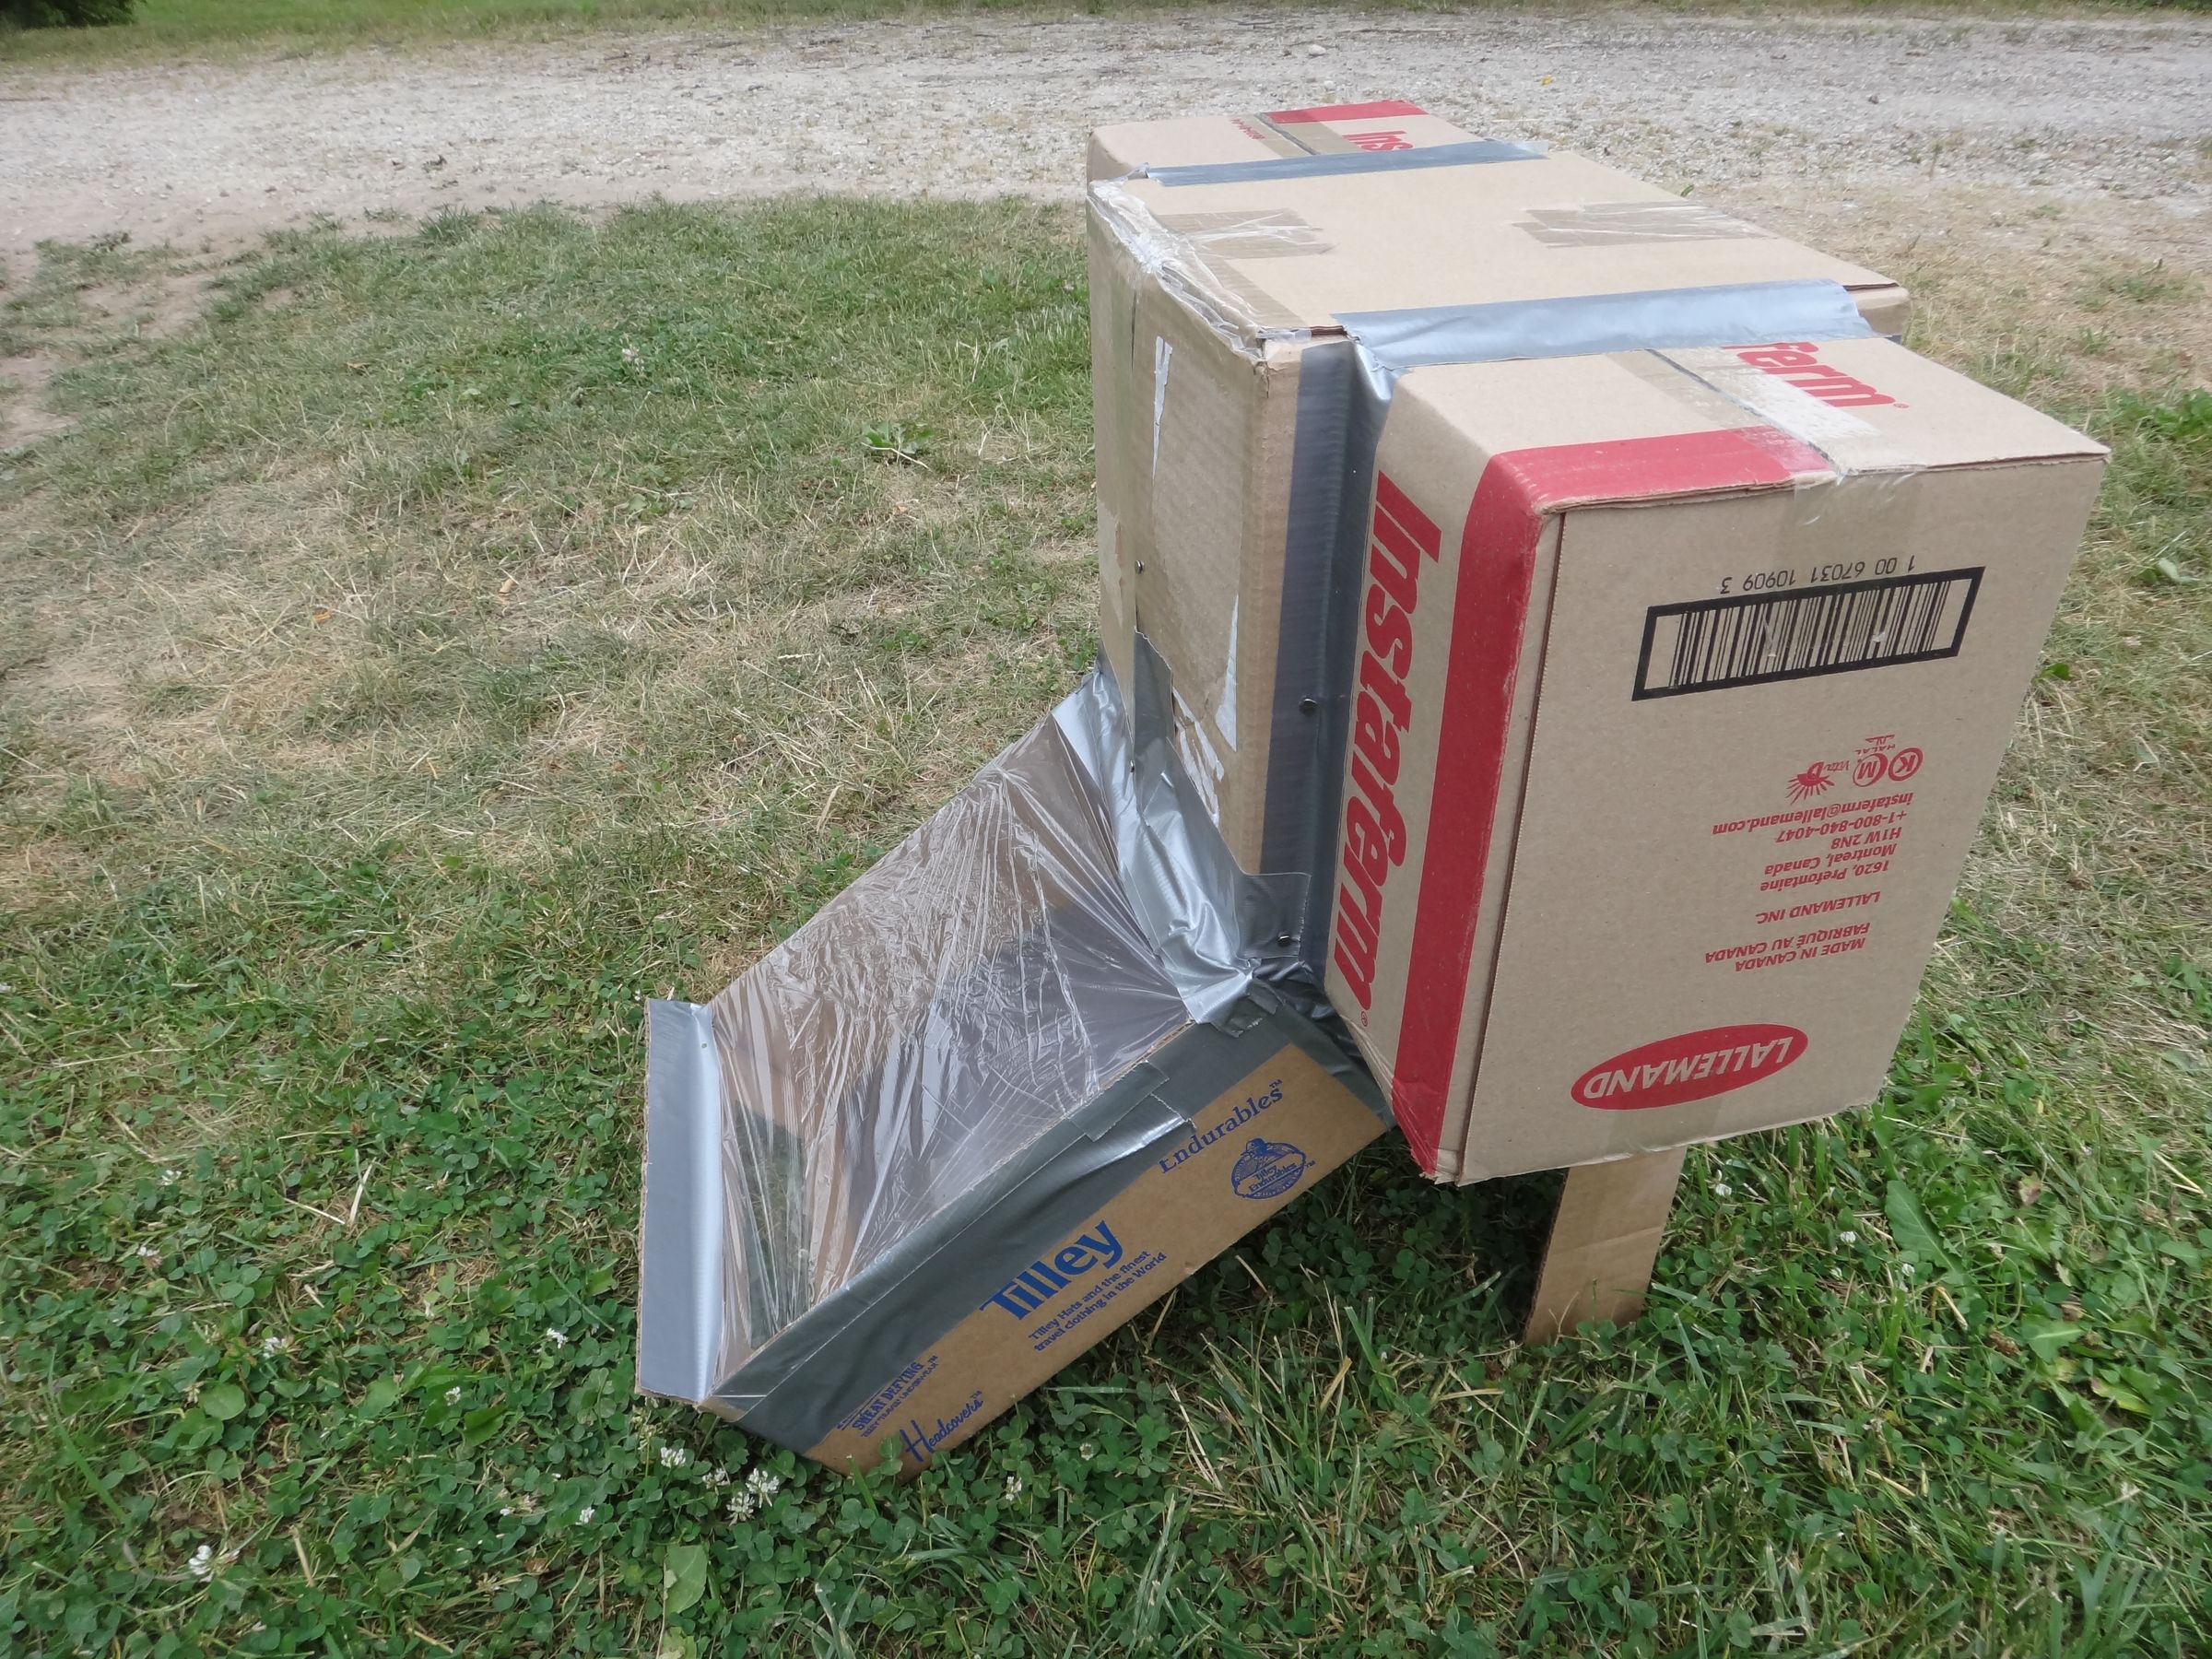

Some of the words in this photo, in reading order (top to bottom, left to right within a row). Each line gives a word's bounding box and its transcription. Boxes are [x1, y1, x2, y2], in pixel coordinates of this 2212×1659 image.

[1809, 560, 1865, 583] 67031
[1874, 557, 1898, 576] 00
[1907, 555, 1916, 573] 1
[1720, 576, 1733, 594] 3
[1742, 569, 1796, 593] 10909
[1711, 792, 1914, 835] instaferm@lallemand.com
[1775, 810, 1908, 843] +1-800-840-4047
[1865, 827, 1902, 844] H1W
[1826, 842, 1898, 867] Montreal,
[1830, 836, 1862, 850] 2N8
[1764, 856, 1821, 877] Canada
[1853, 859, 1889, 877] 1620,
[1759, 867, 1848, 892] Prefontaine
[1789, 890, 1881, 919] LALLEMAND
[1771, 936, 1794, 950] AU
[1796, 922, 1870, 949] FABRIQUÉ
[1821, 936, 1865, 957] MADE
[1705, 942, 1768, 964] CANADA
[1735, 950, 1796, 972] CANADA
[1800, 946, 1818, 960] IN
[1583, 1035, 1794, 1100] LALLEMAND
[979, 1219, 1124, 1321] Tilley
[1028, 1315, 1060, 1341] Tilley
[1057, 1300, 1082, 1320] Hats
[1081, 1286, 1102, 1302] and
[1100, 1272, 1122, 1288] the
[1119, 1250, 1151, 1275] finest
[1033, 1328, 1066, 1352] travel
[1065, 1299, 1108, 1330] clothing
[1105, 1291, 1117, 1302] in
[1115, 1276, 1135, 1292] the
[1133, 1252, 1168, 1278] World
[852, 1398, 888, 1430] SWEAT
[880, 1360, 924, 1402] DEFYING
